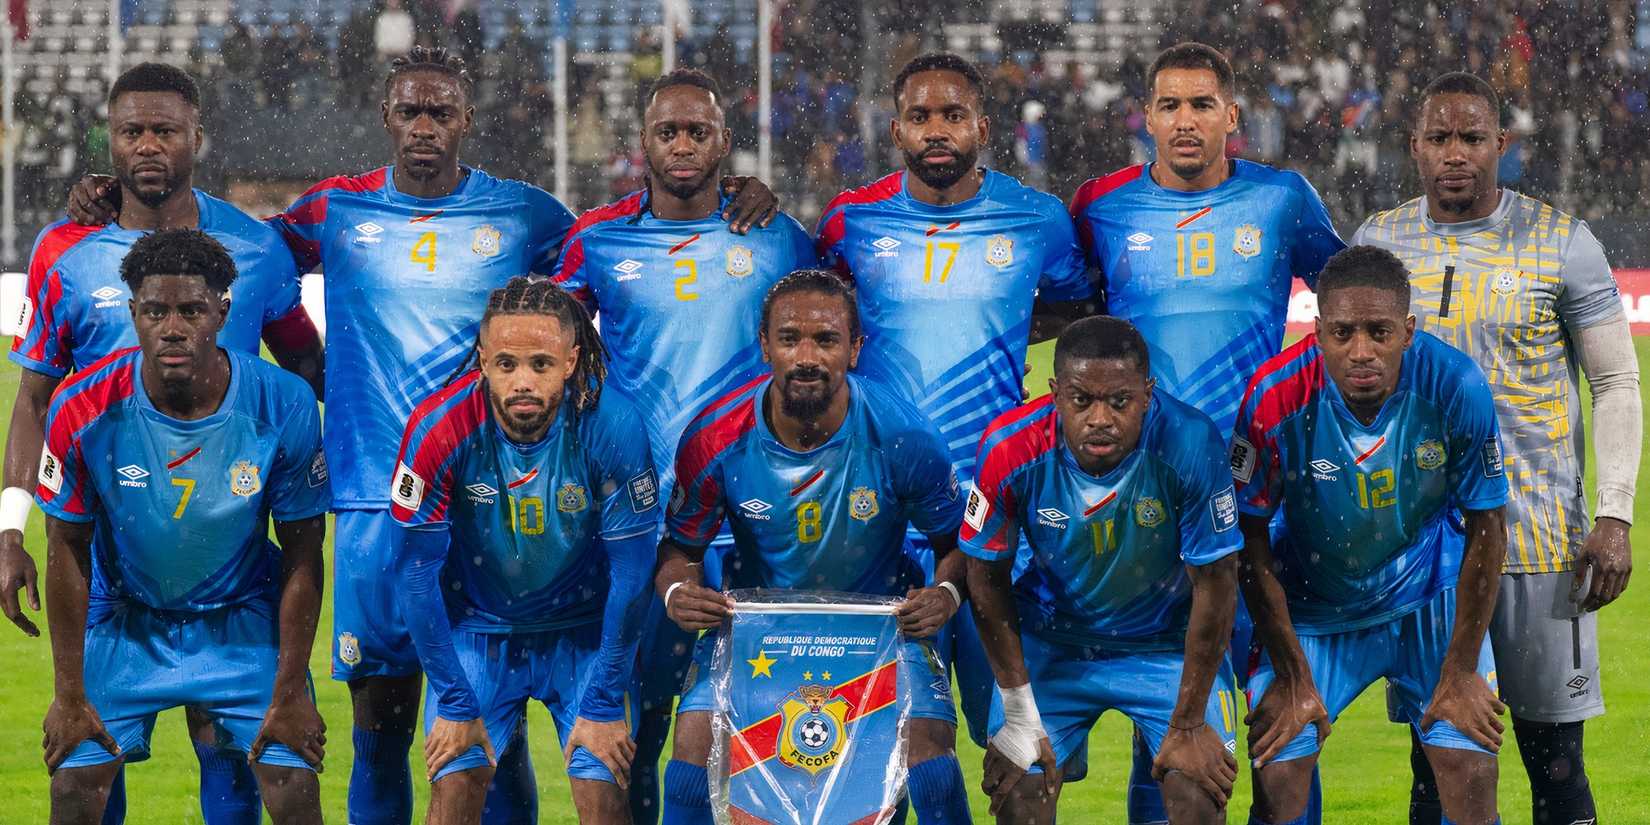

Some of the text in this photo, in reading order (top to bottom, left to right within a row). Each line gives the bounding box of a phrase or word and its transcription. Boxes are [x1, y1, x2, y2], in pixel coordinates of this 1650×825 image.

[410, 231, 438, 272] 4
[923, 240, 961, 284] 17
[1176, 232, 1216, 278] 18
[674, 258, 699, 301] 2
[119, 479, 147, 488] umbro
[1312, 472, 1338, 482] umbro
[1356, 468, 1398, 509] 12
[171, 478, 196, 519] 7
[467, 495, 495, 505] umbro
[508, 494, 545, 535] 10
[744, 512, 771, 521] umbro
[797, 502, 822, 543] 8
[1039, 519, 1067, 530] umbro
[1091, 519, 1116, 555] 11
[762, 635, 878, 646] REPUBLIQUE DEMOCRATIQUE
[791, 645, 845, 657] DU CONGO
[790, 749, 840, 767] FECOFA
